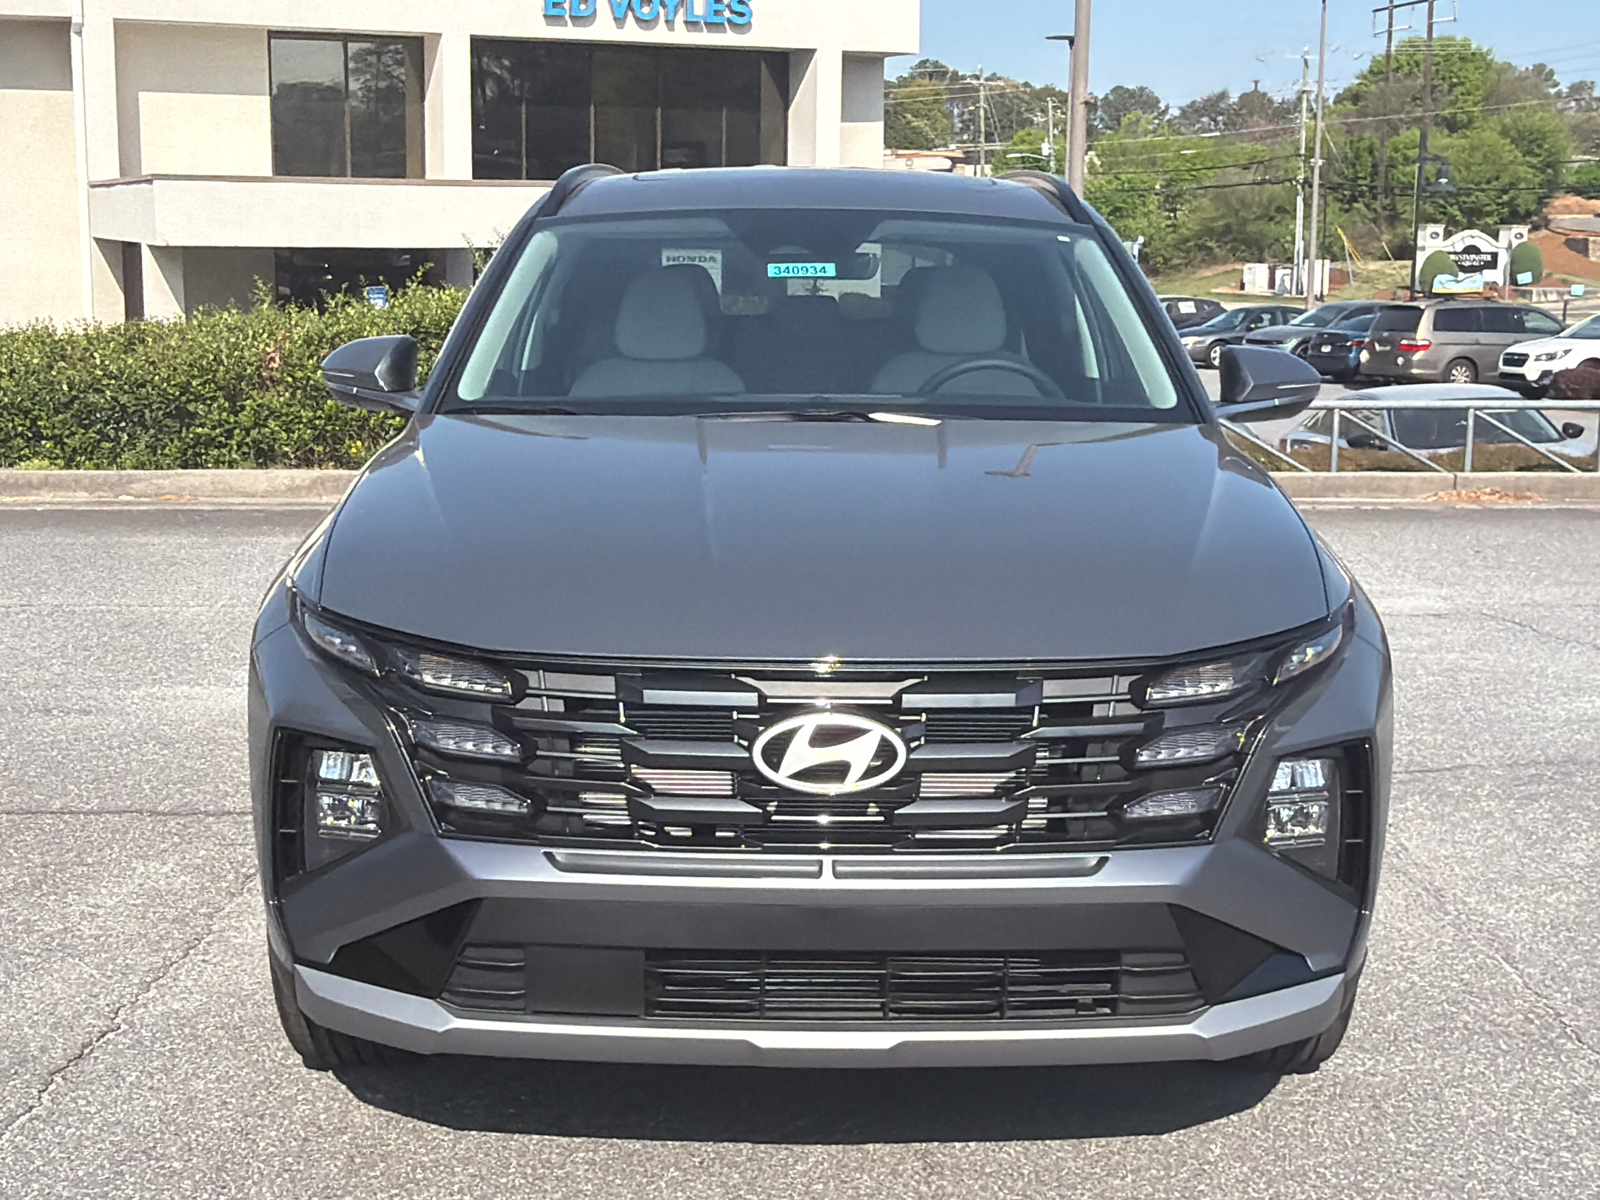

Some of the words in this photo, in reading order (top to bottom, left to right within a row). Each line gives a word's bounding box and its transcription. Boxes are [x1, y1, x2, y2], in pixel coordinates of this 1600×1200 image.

[609, 0, 753, 24] VOYLES
[666, 255, 717, 263] HONDA
[773, 265, 828, 276] 340934
